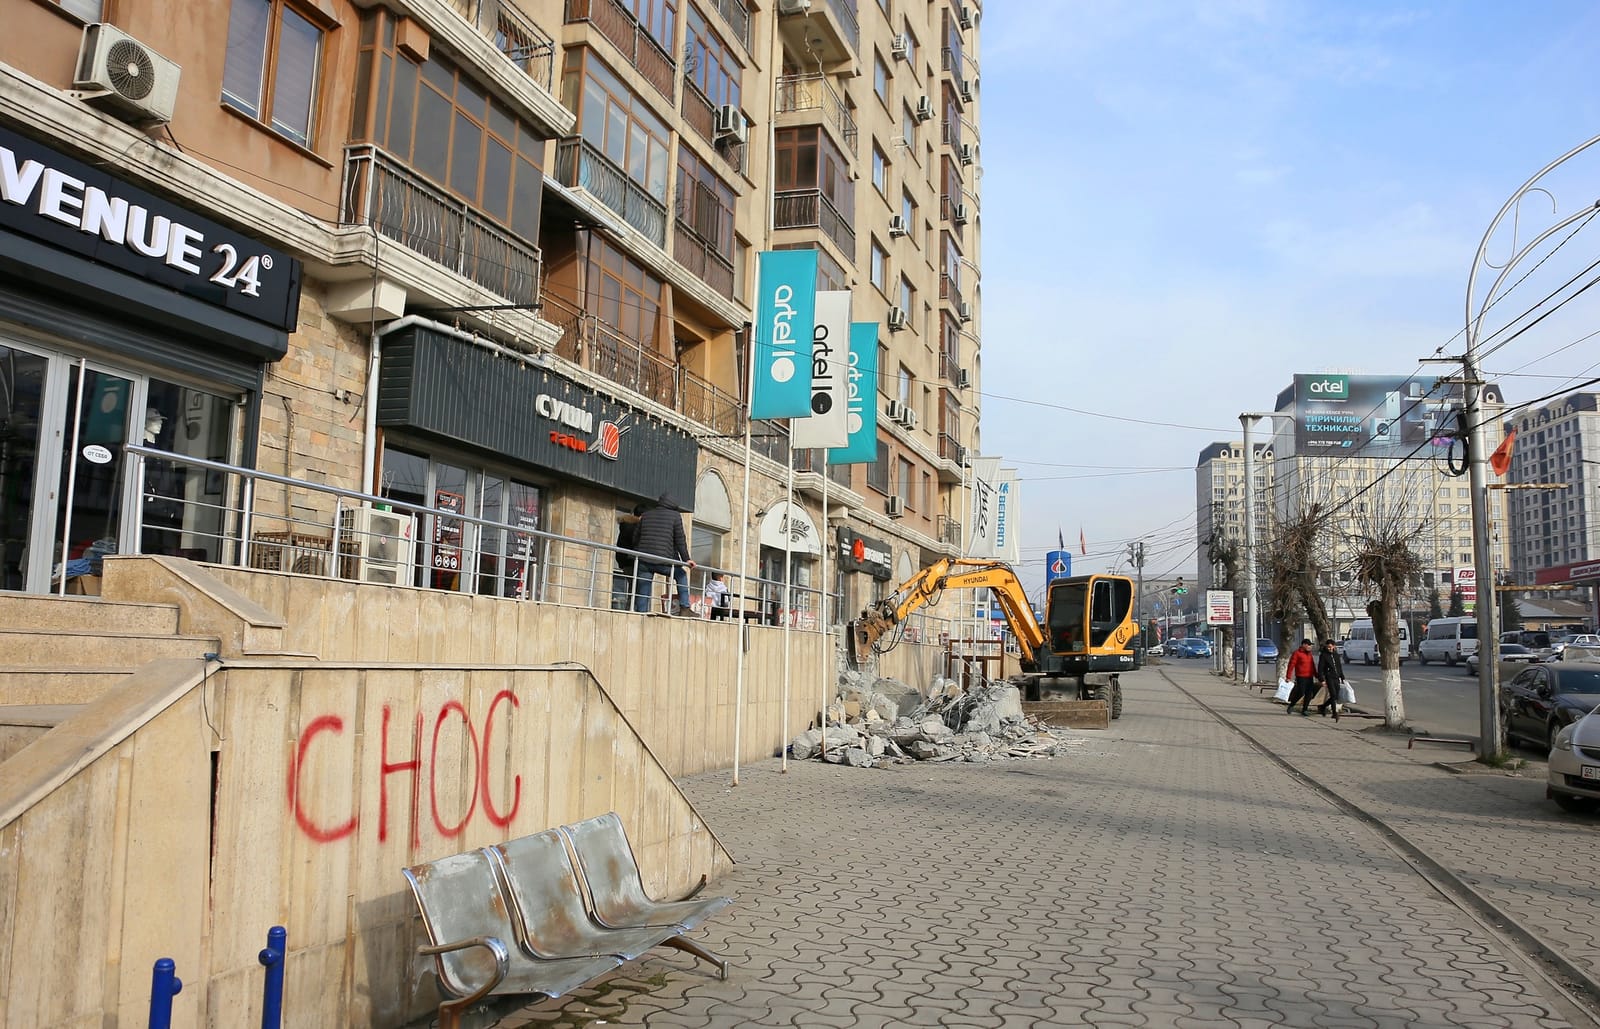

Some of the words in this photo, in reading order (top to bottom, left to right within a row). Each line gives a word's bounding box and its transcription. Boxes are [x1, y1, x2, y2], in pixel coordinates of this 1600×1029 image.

[773, 284, 797, 344] artel
[1311, 380, 1343, 393] artel
[1305, 415, 1361, 423] ТИРИЧИЛИК
[963, 576, 989, 585] HYUNDAI
